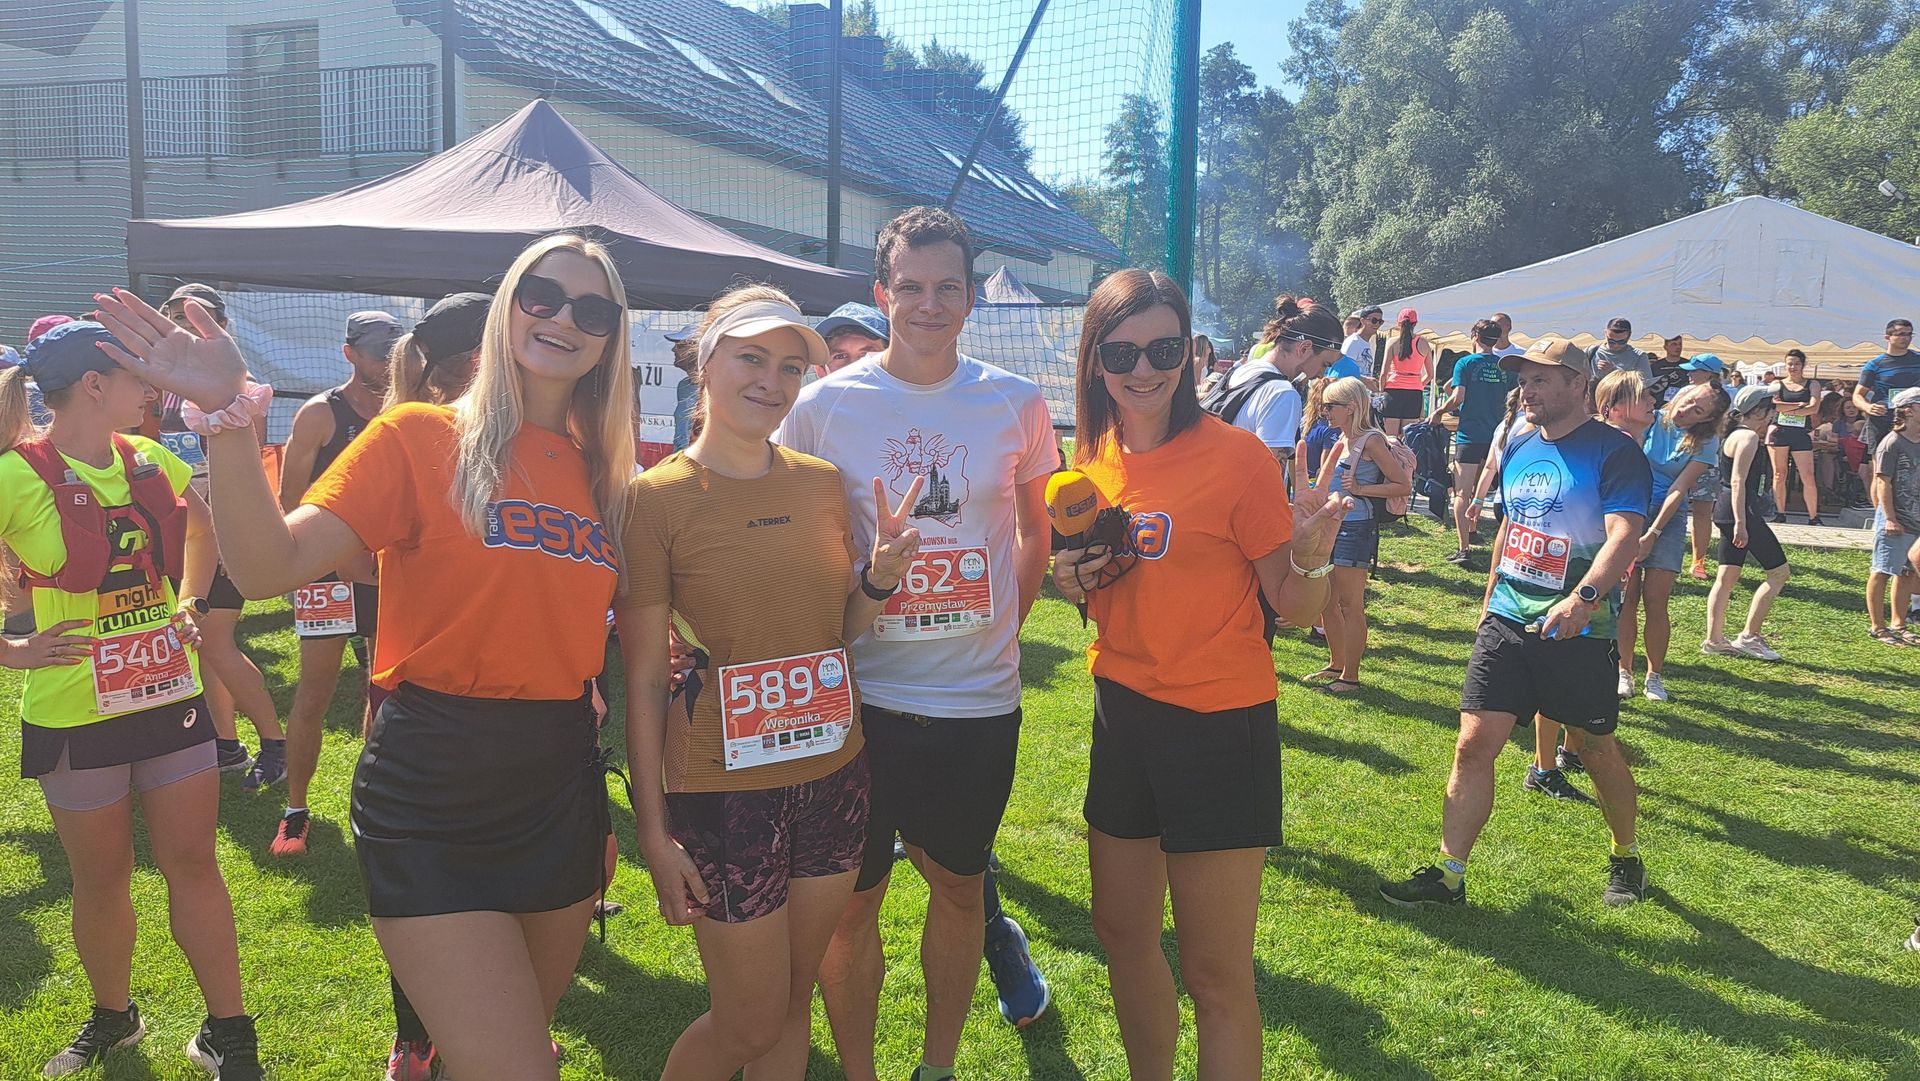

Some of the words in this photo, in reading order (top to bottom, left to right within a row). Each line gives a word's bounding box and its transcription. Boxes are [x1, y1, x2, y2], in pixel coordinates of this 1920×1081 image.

[488, 505, 499, 537] radi
[757, 516, 791, 527] TERREX
[1509, 528, 1545, 558] 600
[893, 559, 954, 595] 62
[98, 604, 169, 633] runners
[900, 600, 966, 612] Przemysław
[100, 634, 171, 675] 540
[144, 671, 169, 683] Anna
[731, 666, 814, 715] 589
[764, 712, 821, 730] Weronika
